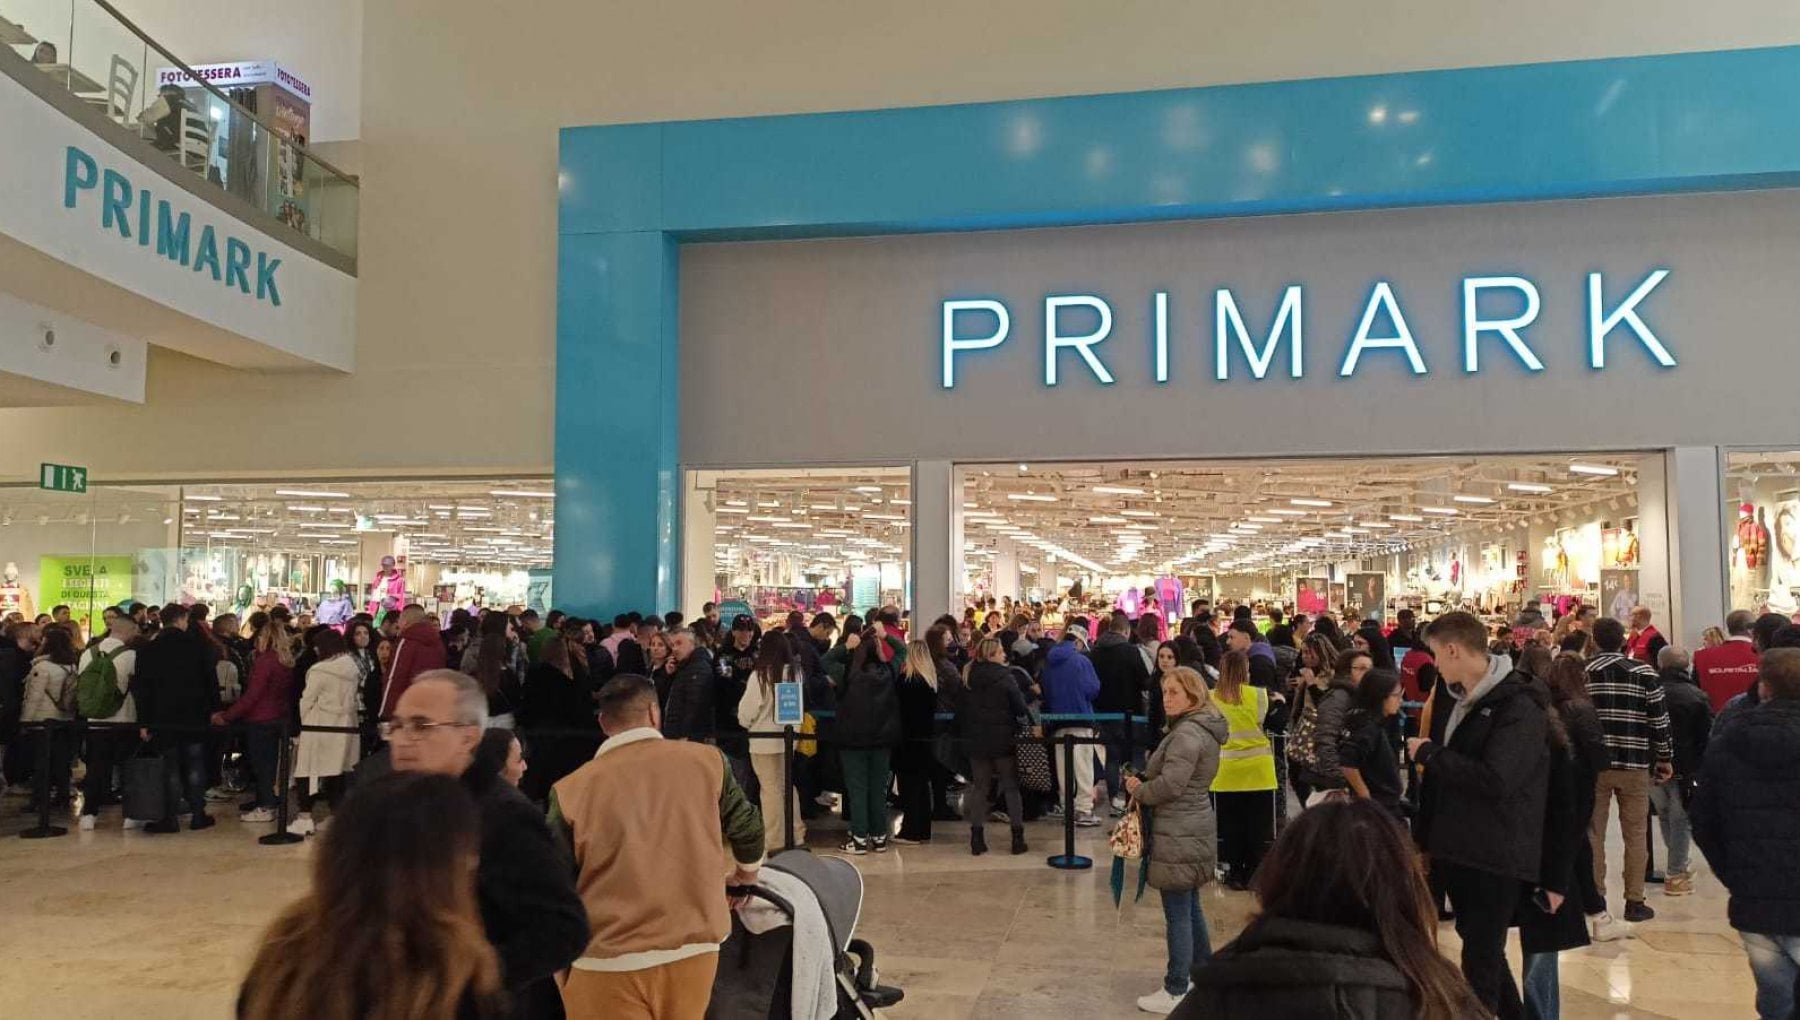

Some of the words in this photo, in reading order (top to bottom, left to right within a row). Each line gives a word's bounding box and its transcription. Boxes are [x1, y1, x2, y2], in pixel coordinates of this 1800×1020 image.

[161, 67, 241, 83] FOTOESSERA
[277, 68, 311, 96] FOTOTESSERA
[65, 146, 282, 306] PRIMARK
[942, 269, 1677, 389] PRIMARK
[64, 564, 107, 577] SVEA
